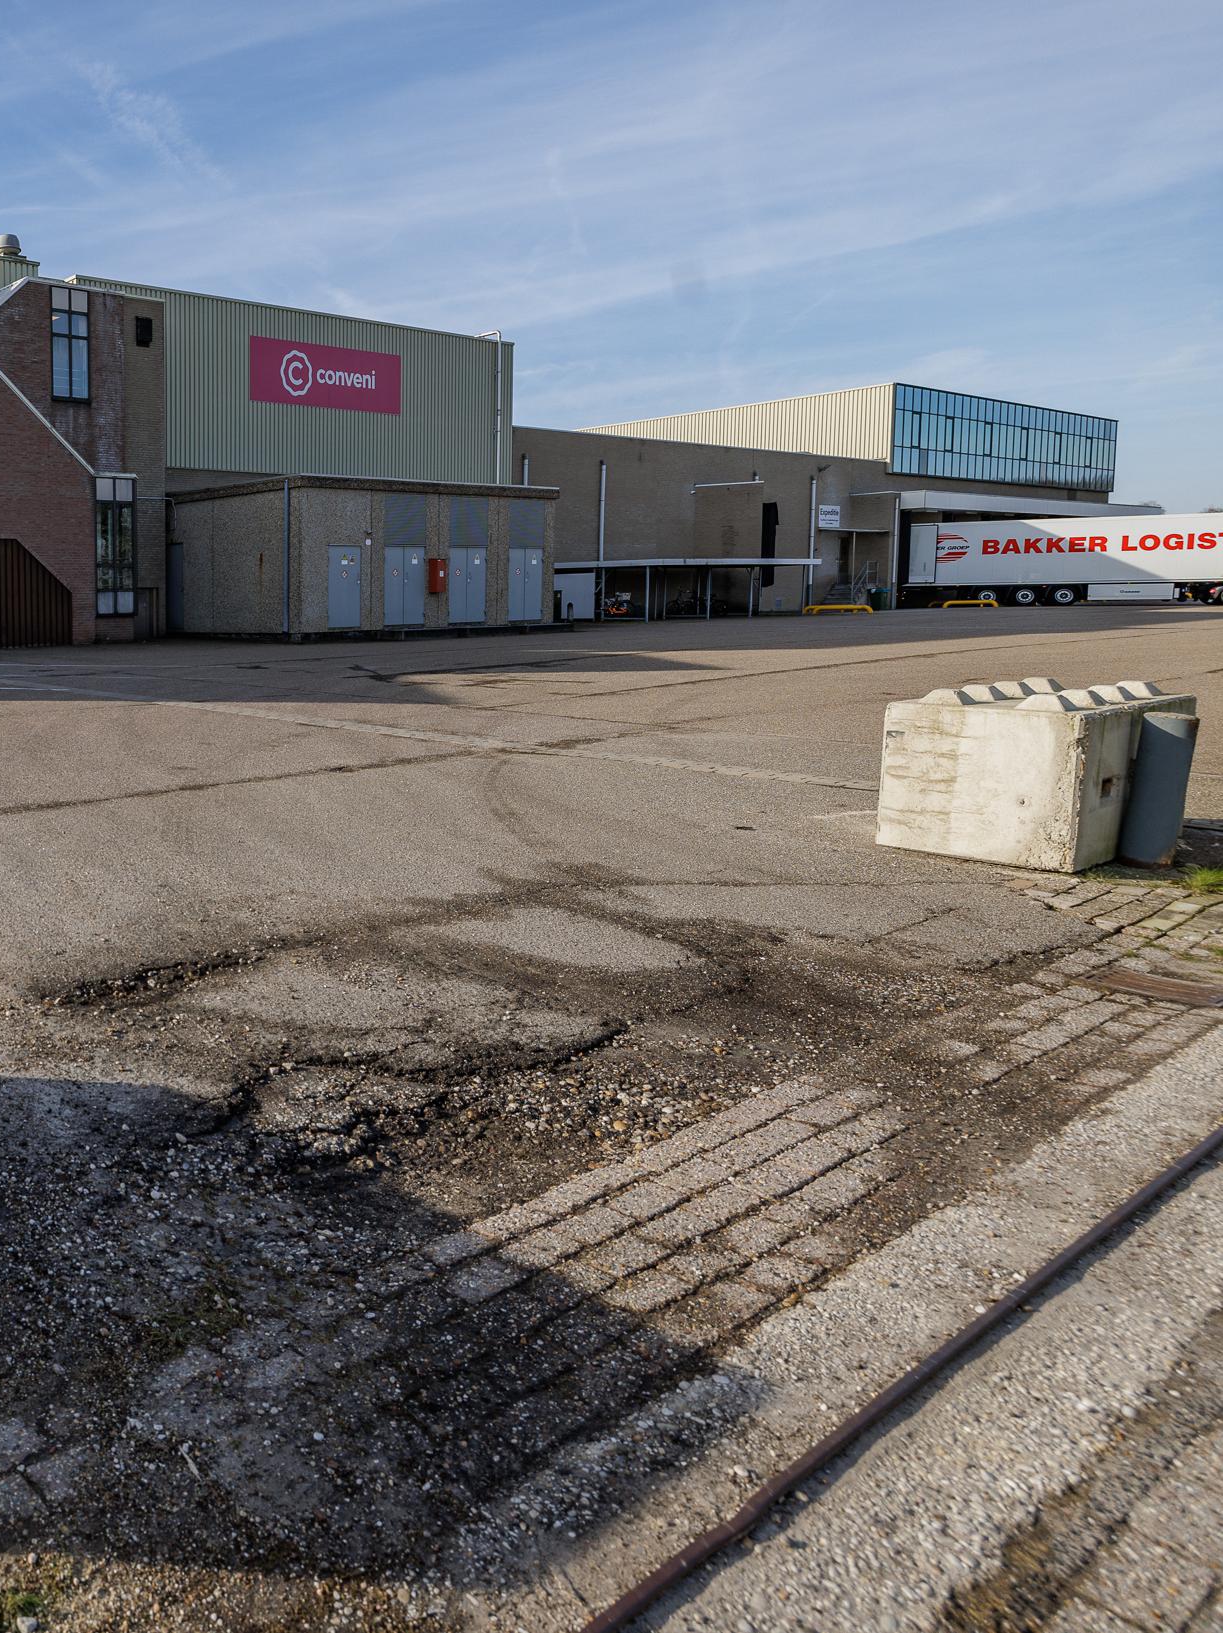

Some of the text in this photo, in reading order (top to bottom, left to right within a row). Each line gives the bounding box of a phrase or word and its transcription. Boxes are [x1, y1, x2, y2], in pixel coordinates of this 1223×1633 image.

[316, 368, 376, 389] conveni
[820, 507, 839, 517] Expeditie
[982, 536, 1108, 555] BAKKER
